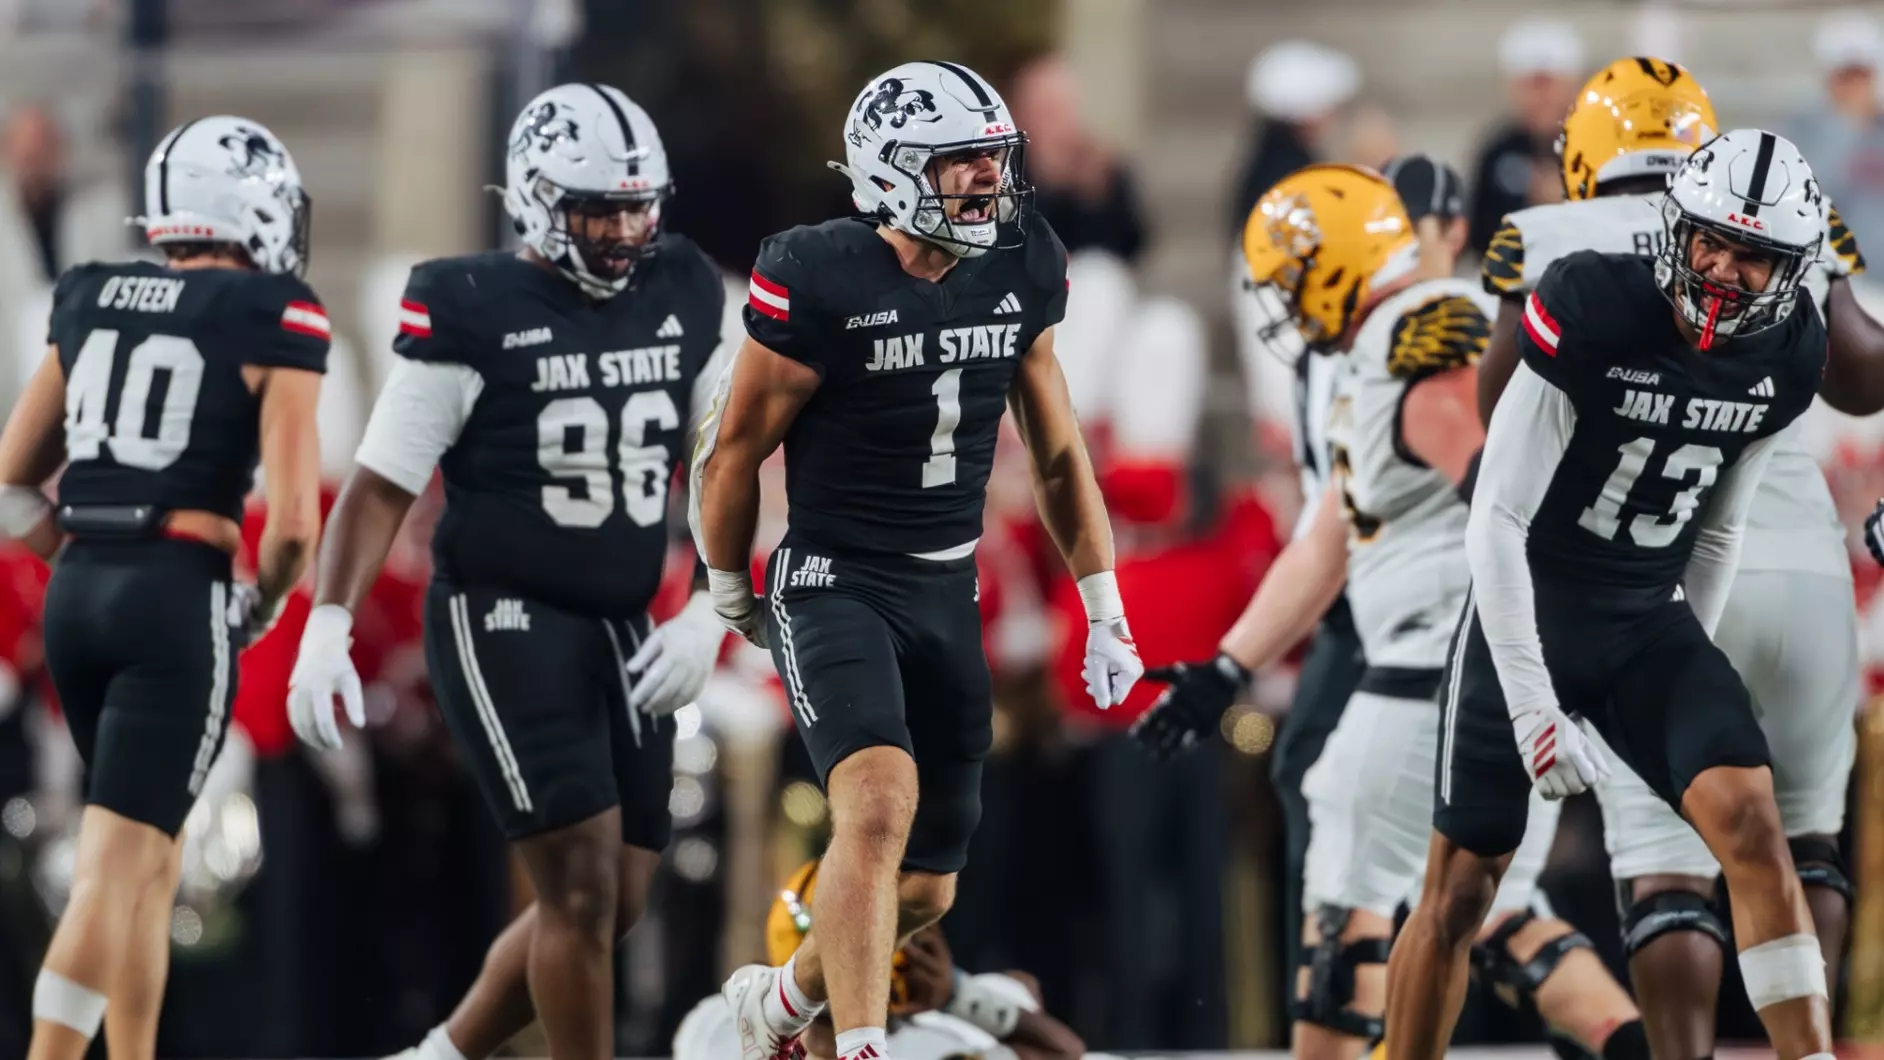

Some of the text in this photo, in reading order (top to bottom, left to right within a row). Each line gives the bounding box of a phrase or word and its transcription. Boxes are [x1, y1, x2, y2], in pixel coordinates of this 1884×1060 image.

[97, 275, 186, 313] O'STEEN
[530, 344, 681, 392] JAX STATE
[865, 323, 1022, 371] JAX STATE
[63, 328, 206, 472] 40
[1612, 389, 1769, 433] JAX STATE
[921, 368, 963, 489] 1
[537, 391, 679, 528] 96
[1576, 436, 1724, 548] 13
[790, 570, 837, 588] STATE
[801, 555, 833, 574] JAX
[485, 612, 531, 632] STATE
